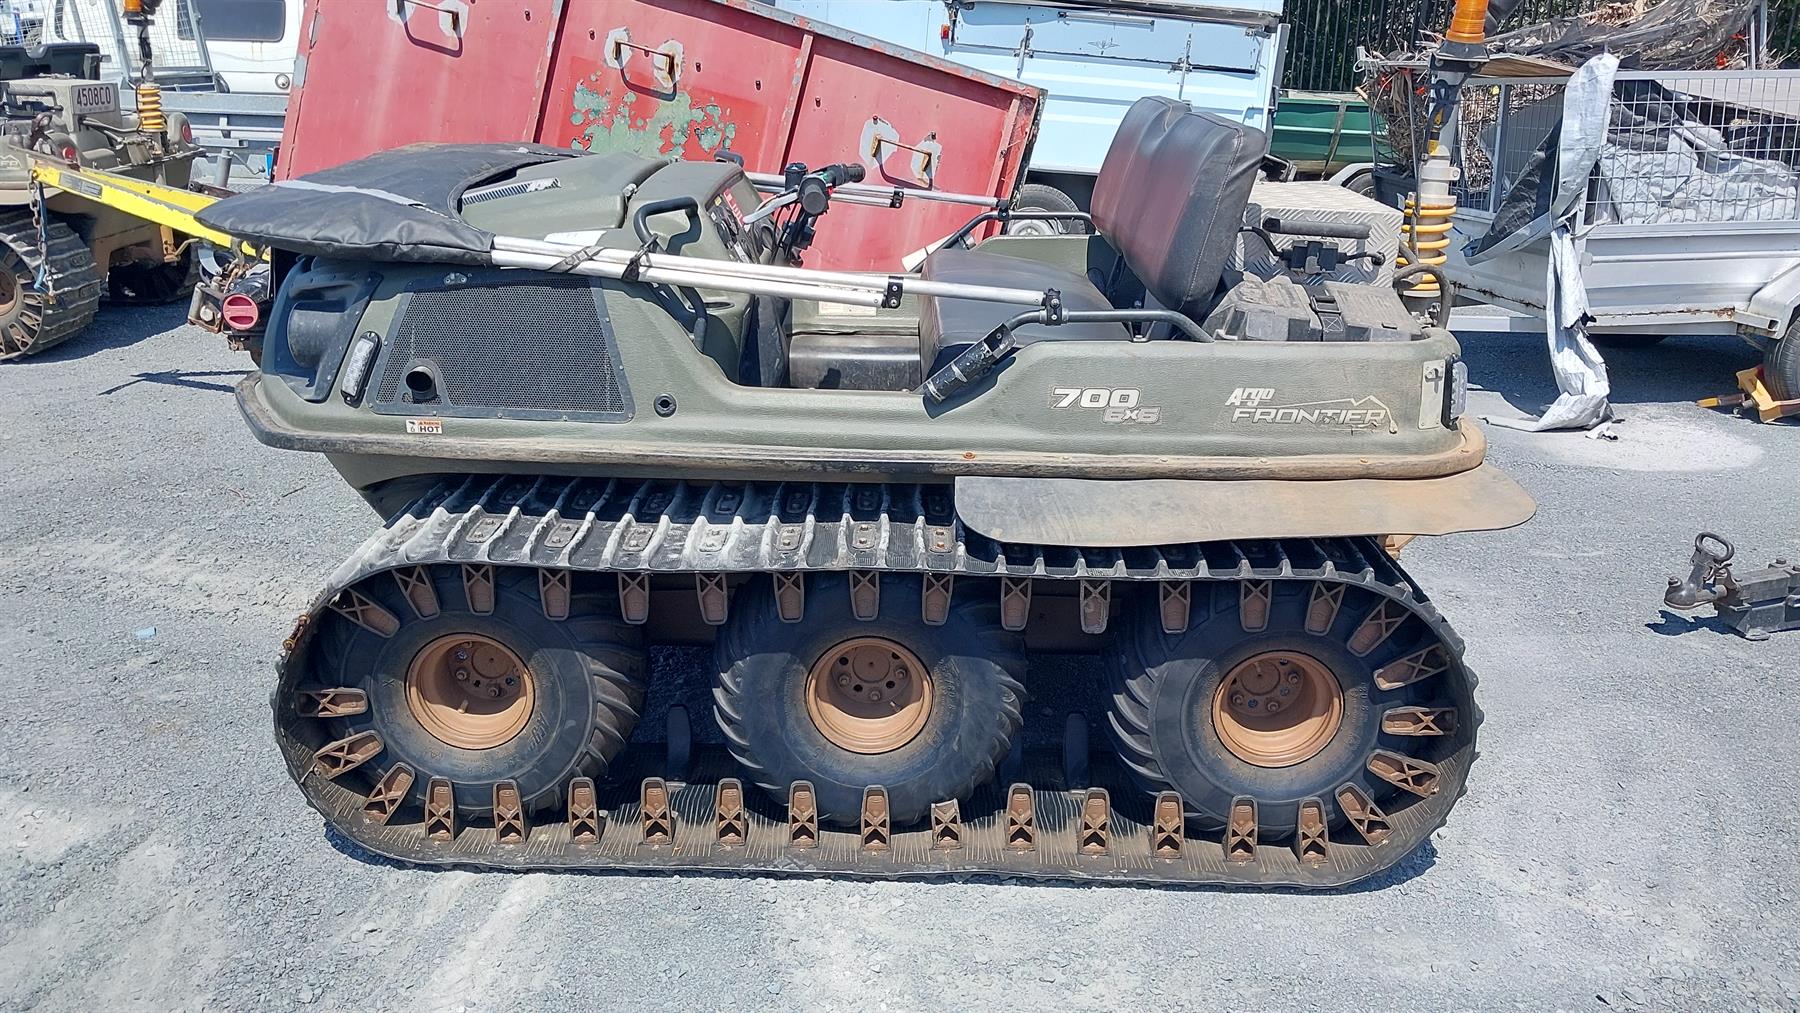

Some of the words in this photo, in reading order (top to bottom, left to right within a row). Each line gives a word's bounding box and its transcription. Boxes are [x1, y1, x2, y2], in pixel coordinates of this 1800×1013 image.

[1051, 387, 1141, 409] 700
[1225, 387, 1275, 406] Argo
[1231, 408, 1386, 424] FRONTIER
